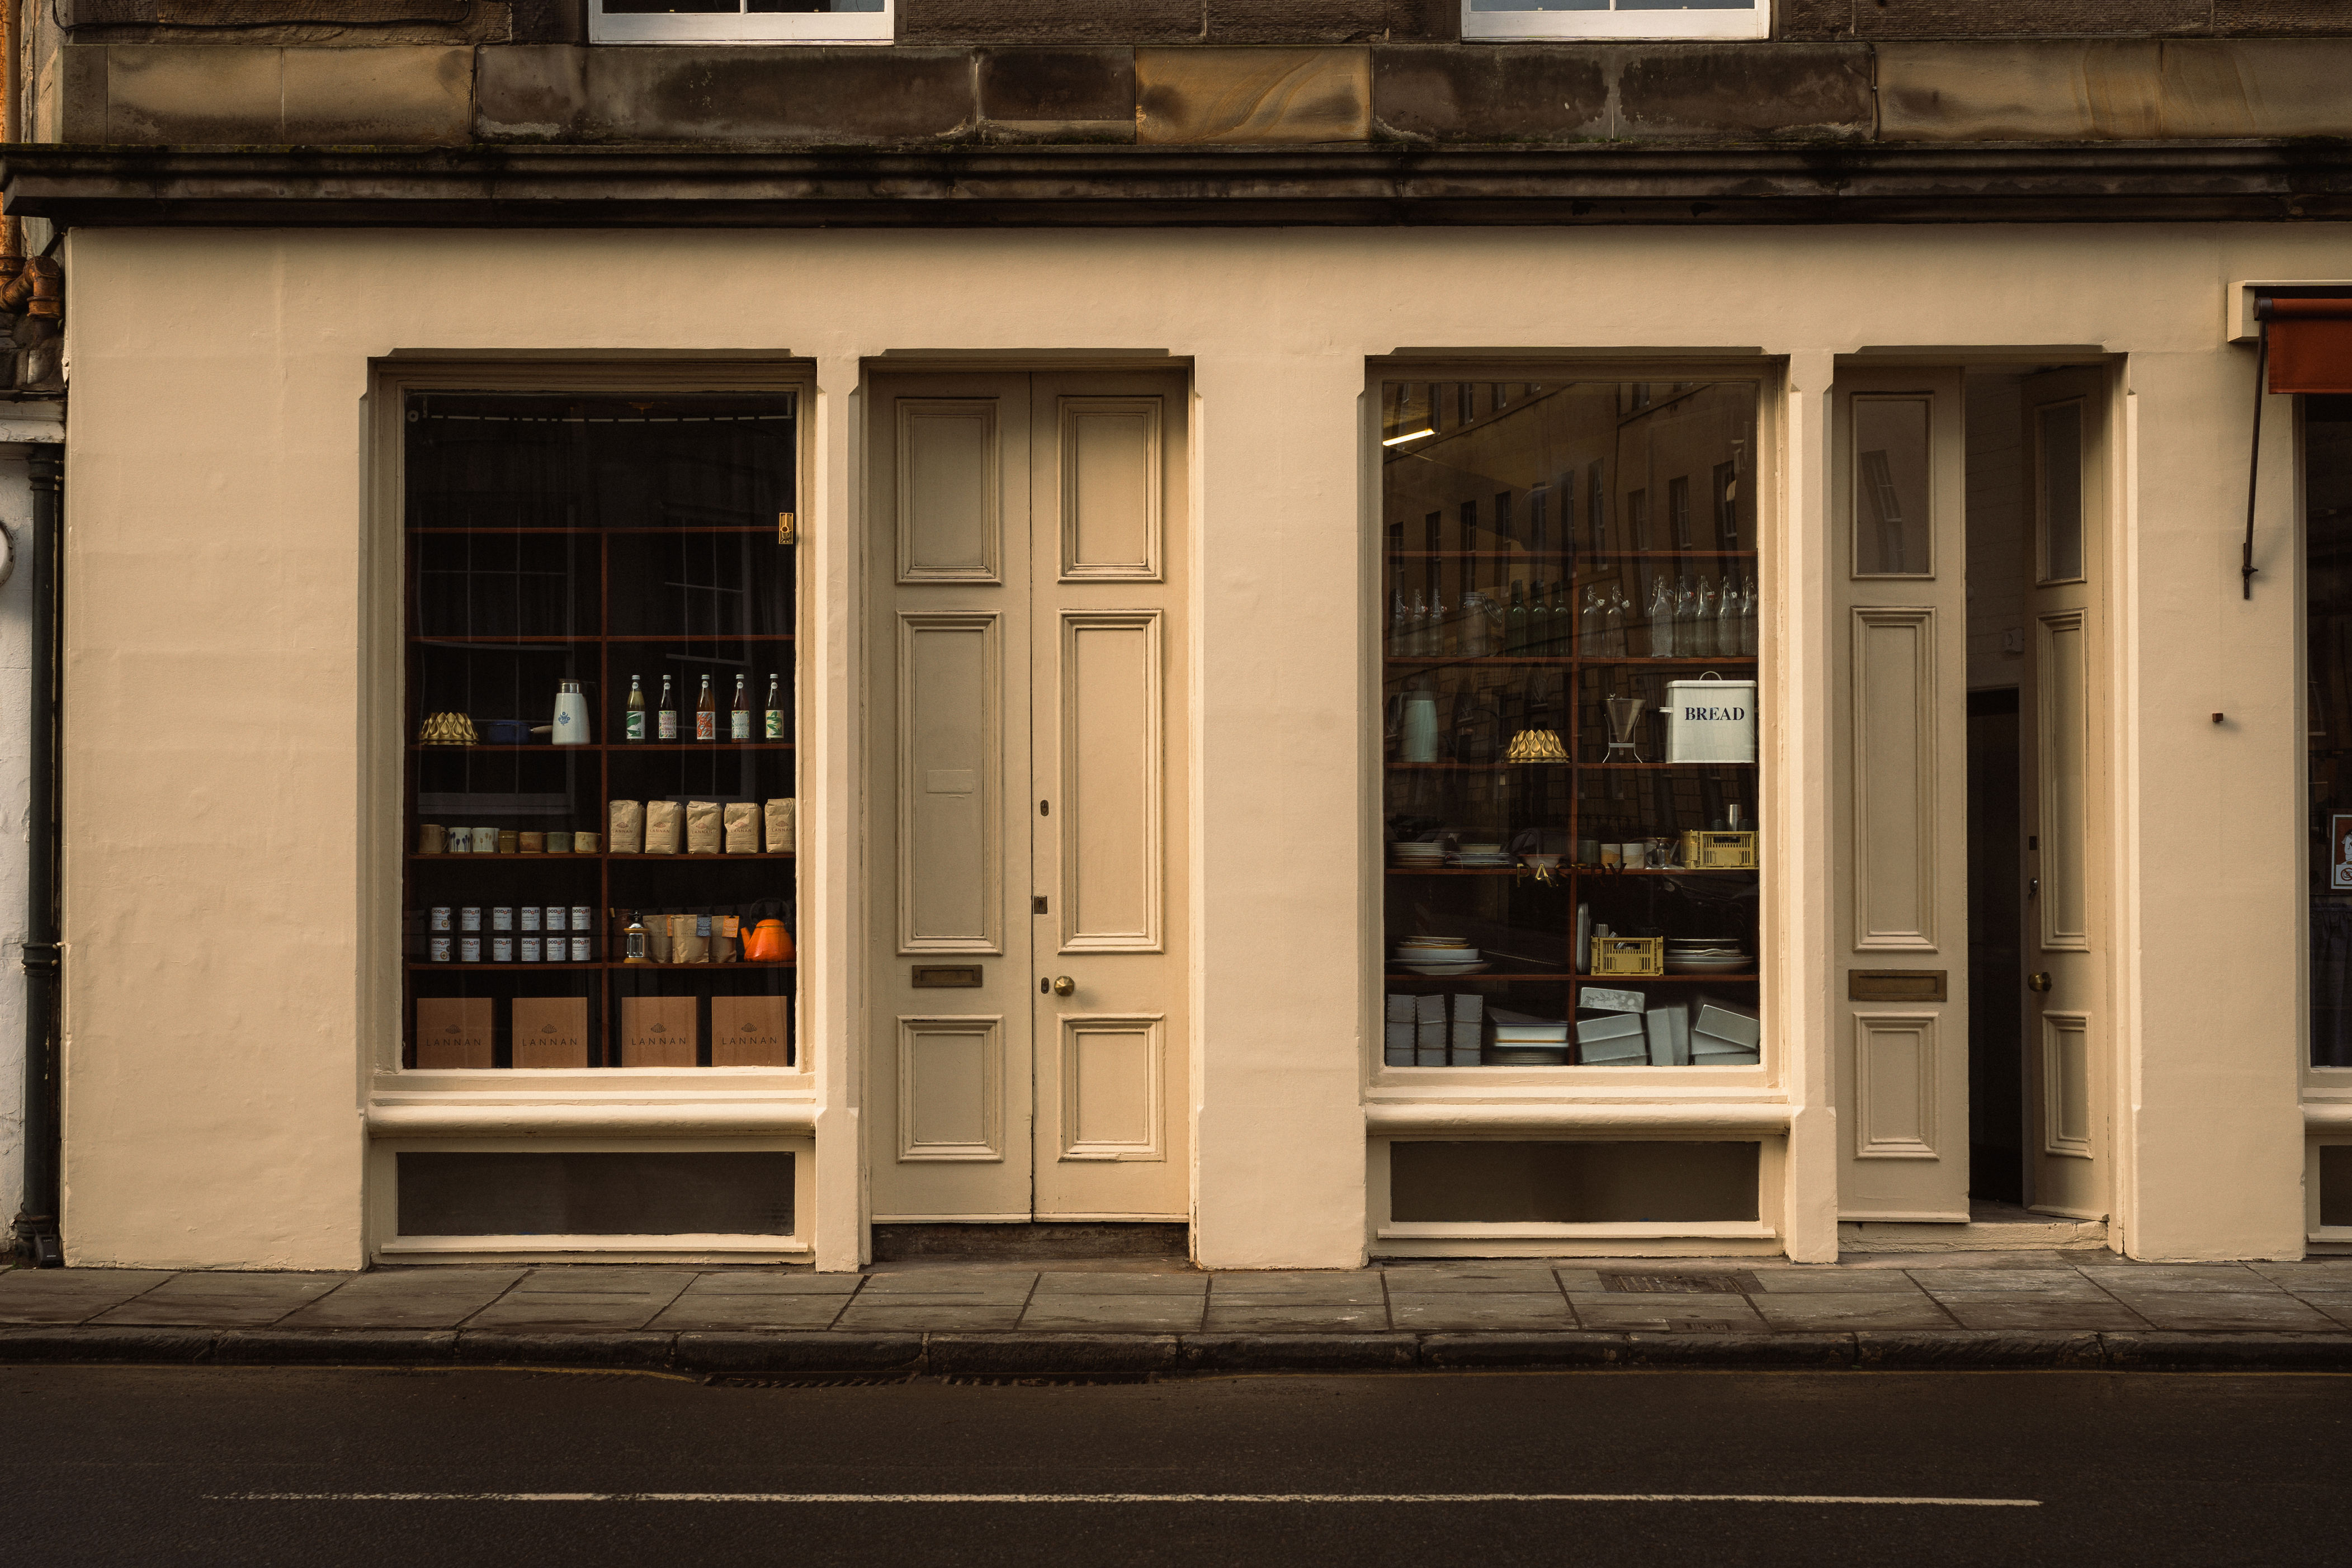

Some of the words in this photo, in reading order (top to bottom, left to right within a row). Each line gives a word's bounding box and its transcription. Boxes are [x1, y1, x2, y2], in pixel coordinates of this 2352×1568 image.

[1685, 707, 1744, 720] BREAD
[1516, 863, 1627, 888] PASTRY
[522, 1038, 578, 1046] LANNAN
